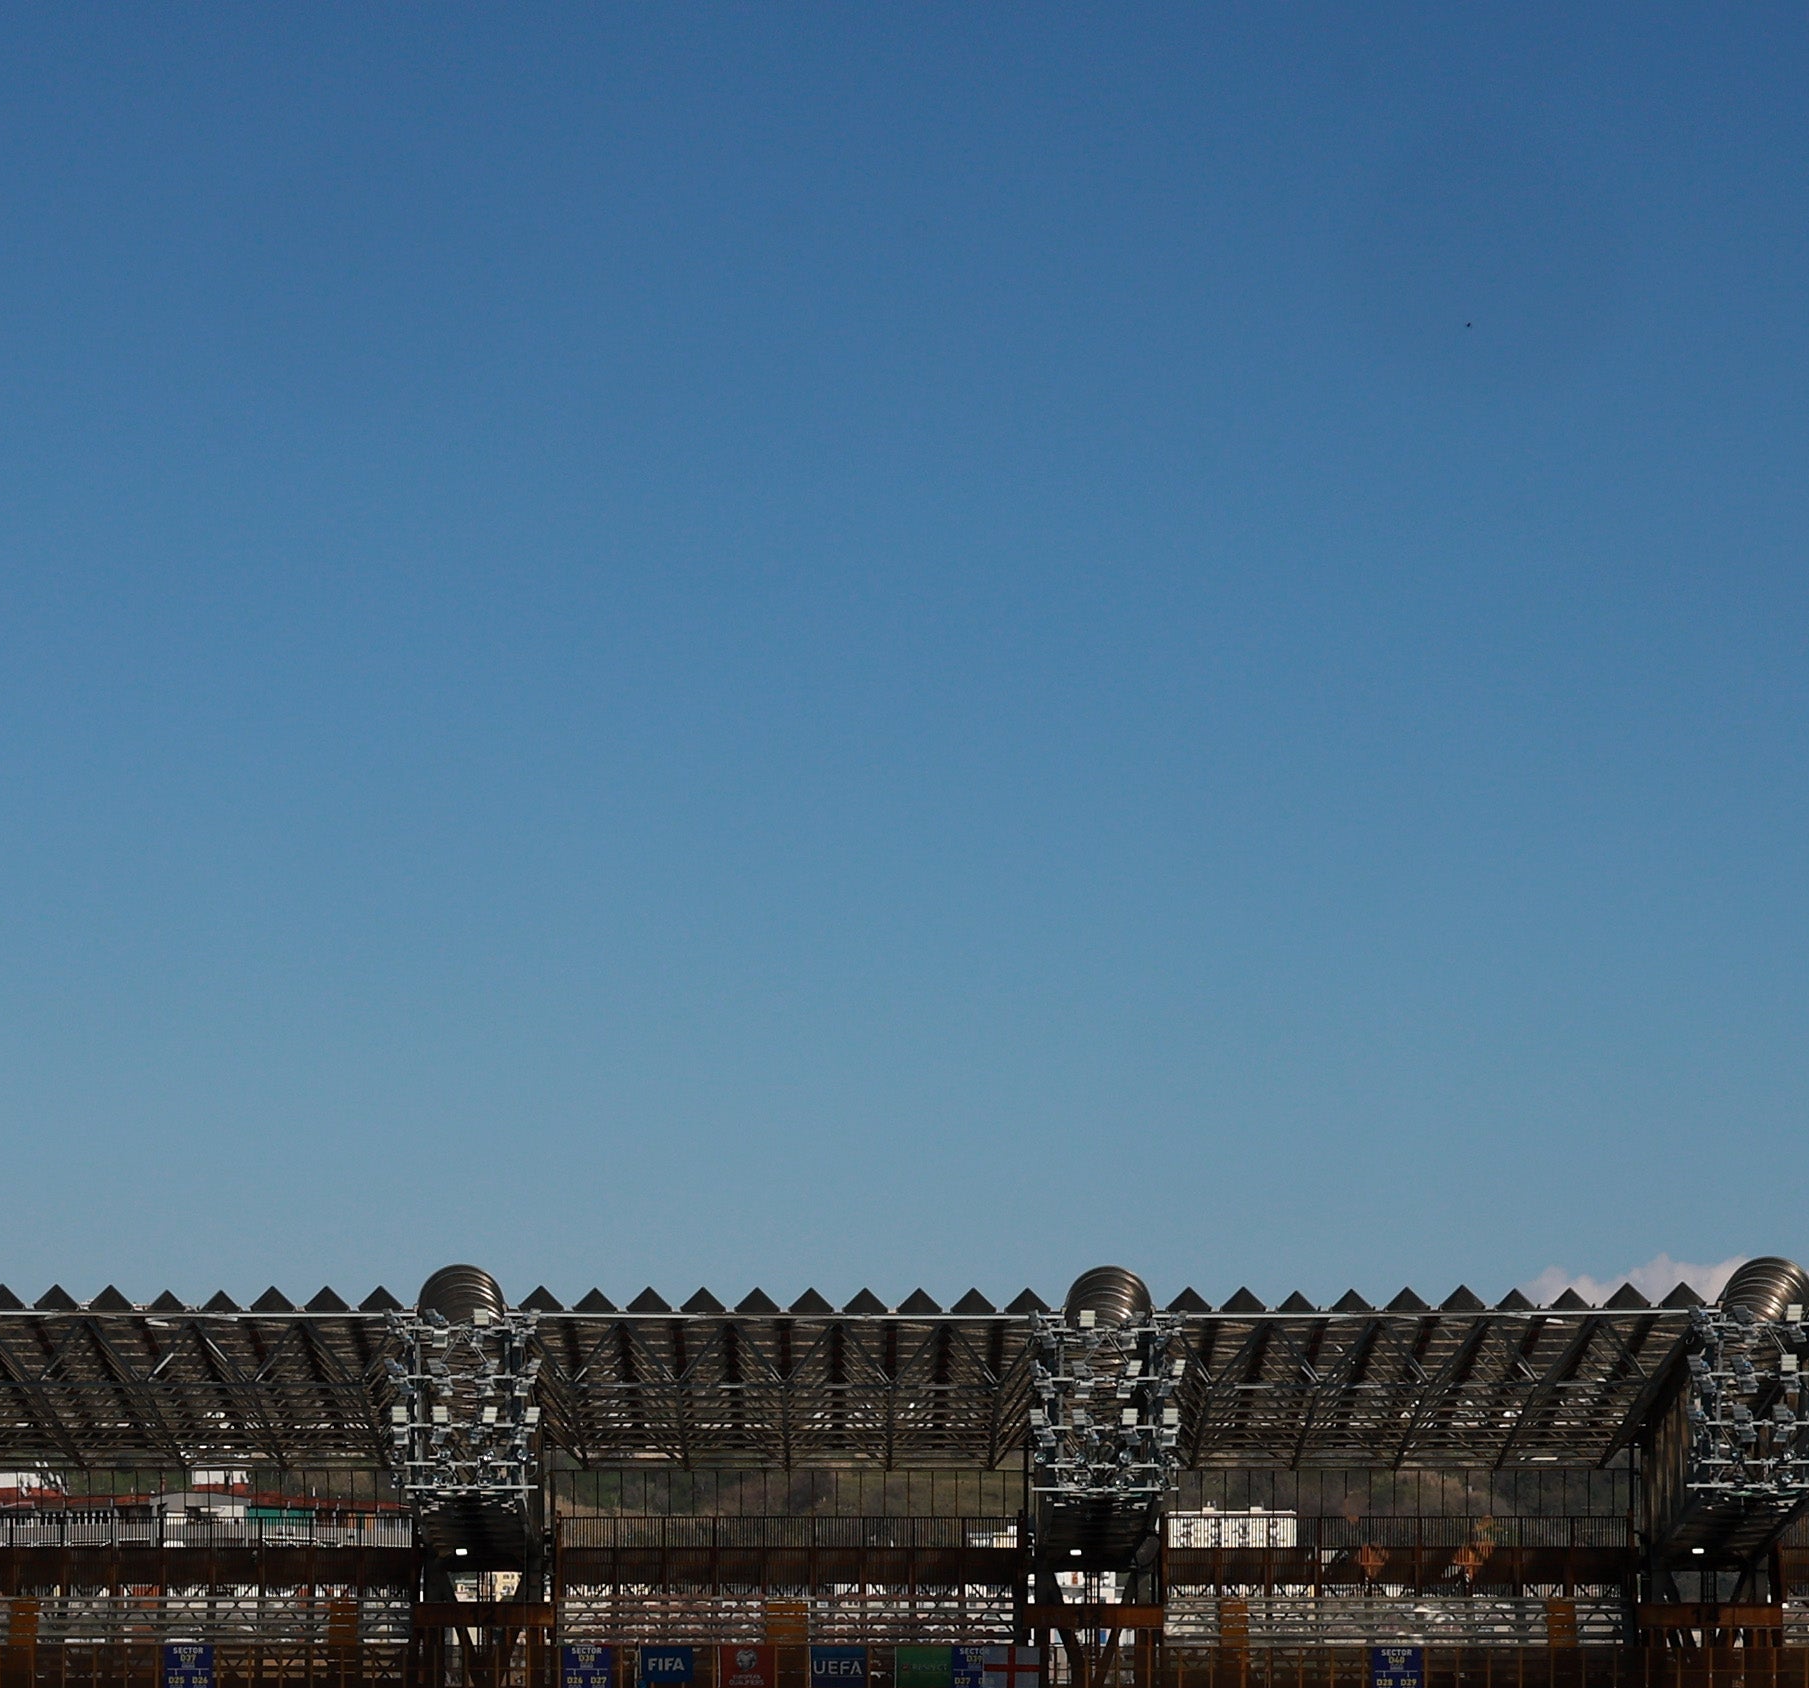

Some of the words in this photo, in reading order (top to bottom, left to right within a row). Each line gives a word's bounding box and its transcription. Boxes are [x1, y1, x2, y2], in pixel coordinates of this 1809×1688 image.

[173, 1647, 204, 1655] SECTOR
[572, 1647, 603, 1655] SECTOR
[648, 1657, 685, 1672] FIFA
[813, 1660, 862, 1675] UEFA
